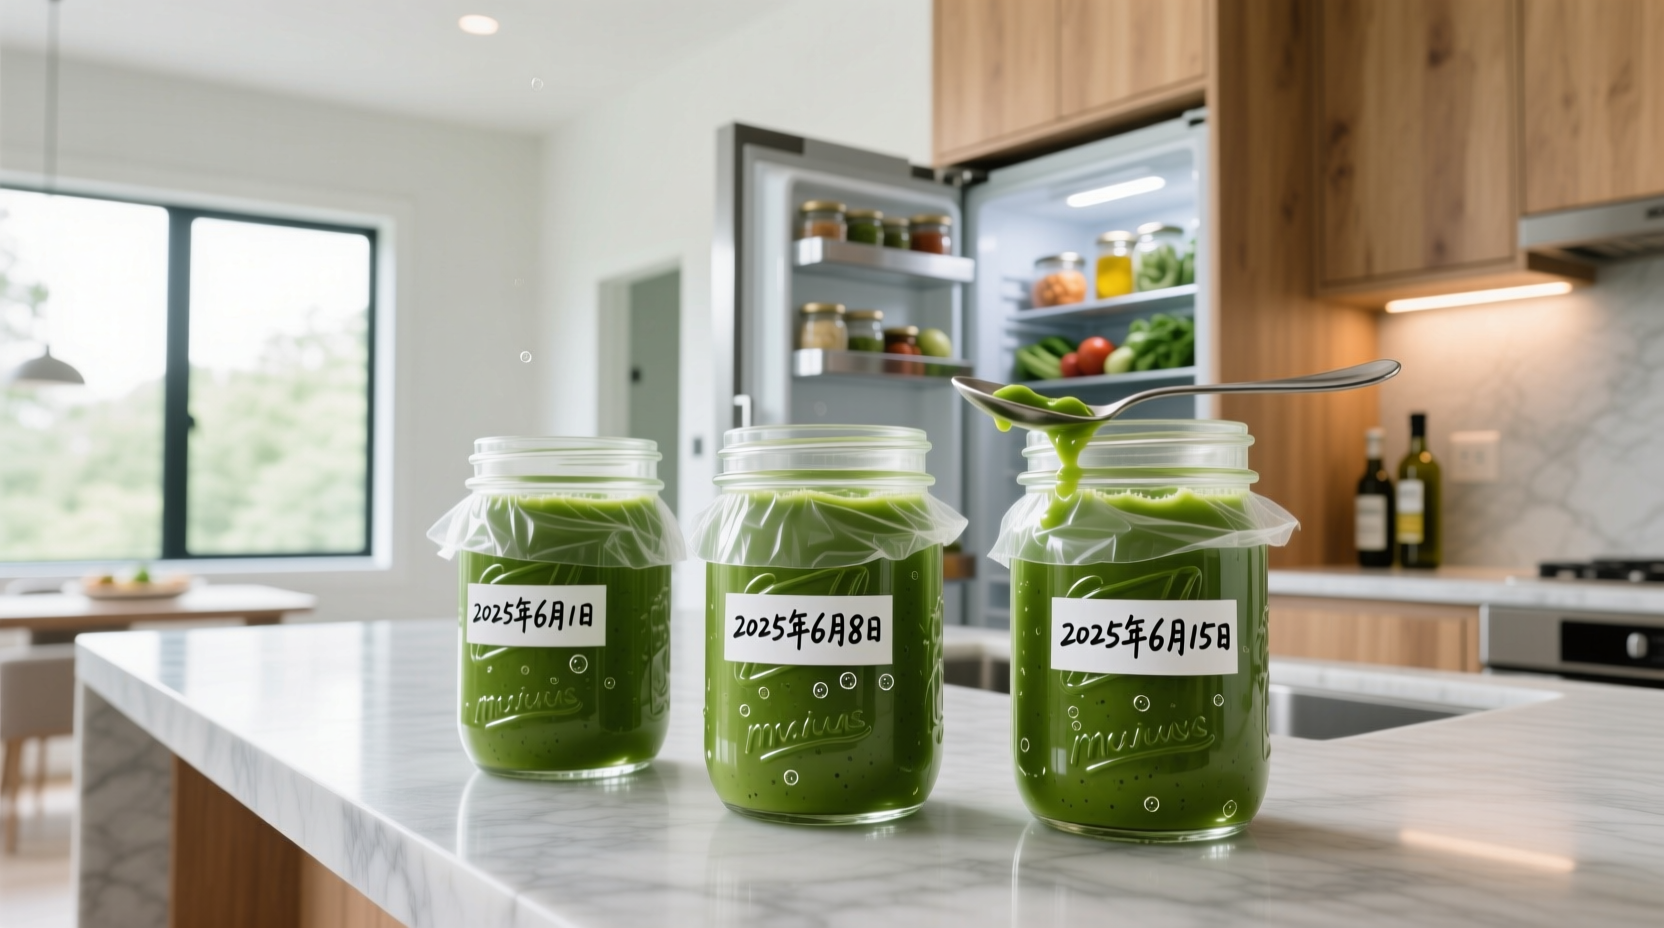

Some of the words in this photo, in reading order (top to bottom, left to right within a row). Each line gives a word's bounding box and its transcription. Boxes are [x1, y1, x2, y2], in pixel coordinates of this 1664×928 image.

[473, 597, 593, 633] 2025年6月1日
[733, 609, 881, 651] 2025年6月8日
[1060, 614, 1231, 660] 2025年6月15日
